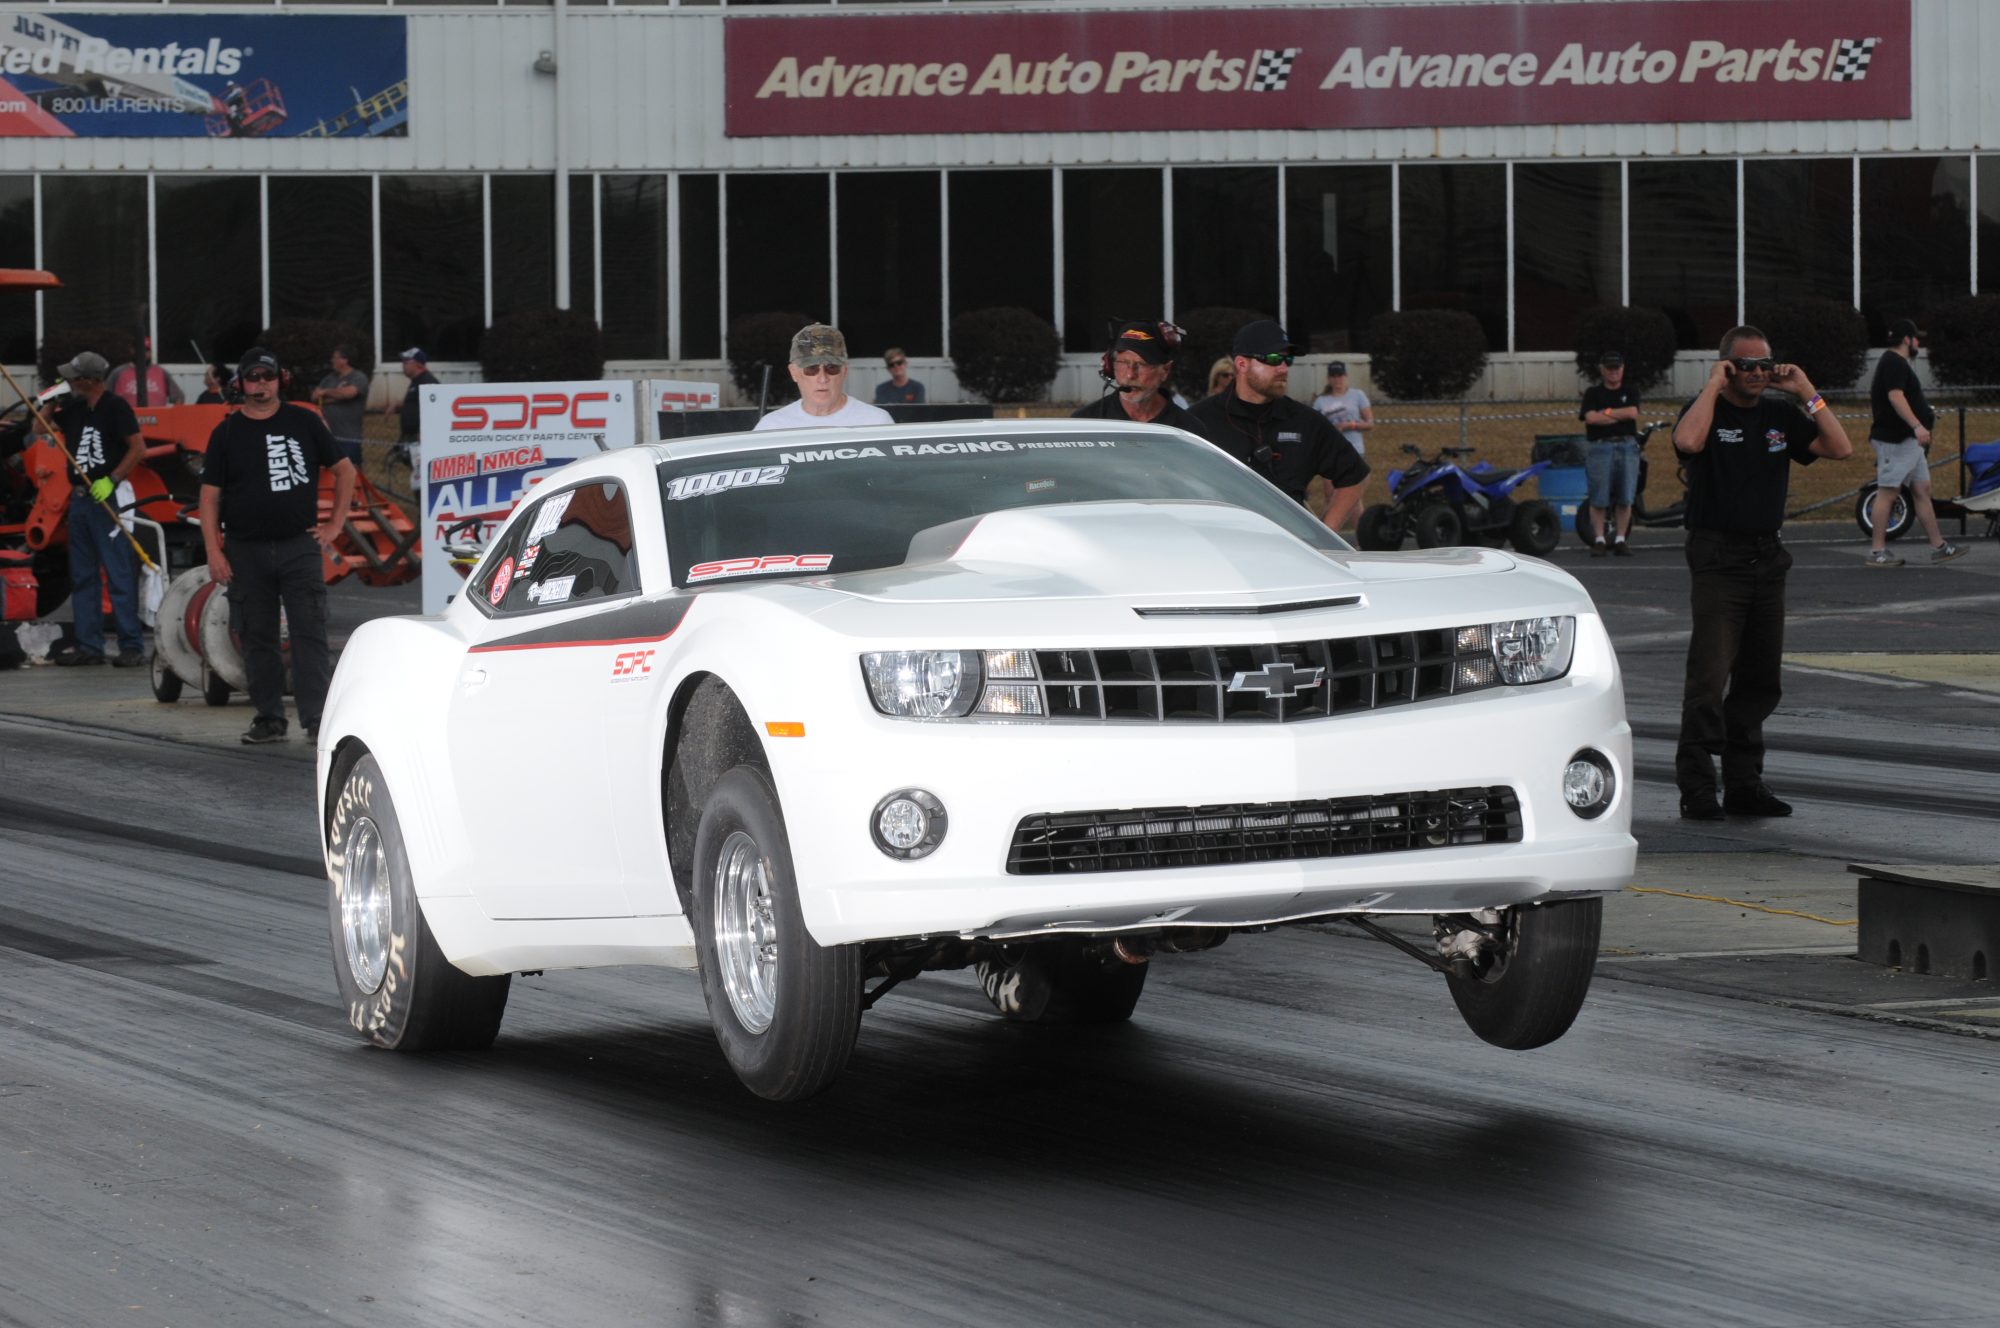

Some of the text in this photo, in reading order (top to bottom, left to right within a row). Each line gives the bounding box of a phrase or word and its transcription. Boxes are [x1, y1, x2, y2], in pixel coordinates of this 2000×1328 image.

[74, 37, 242, 76] Rentals
[756, 48, 1247, 99] Advance Auto Parts
[1319, 37, 1826, 91] Advance Auto Parts
[451, 392, 609, 431] SDPC
[448, 434, 494, 443] SCOGGIN
[495, 433, 532, 442] DICKEY
[533, 433, 565, 441] PARTS
[779, 447, 887, 464] NMCA
[891, 441, 1015, 456] RACING
[1017, 441, 1095, 450] PRESENTED
[265, 433, 291, 492] EVENT
[286, 436, 310, 486] Team
[430, 445, 546, 480] NMRA NMCA
[690, 555, 832, 578] SDPC
